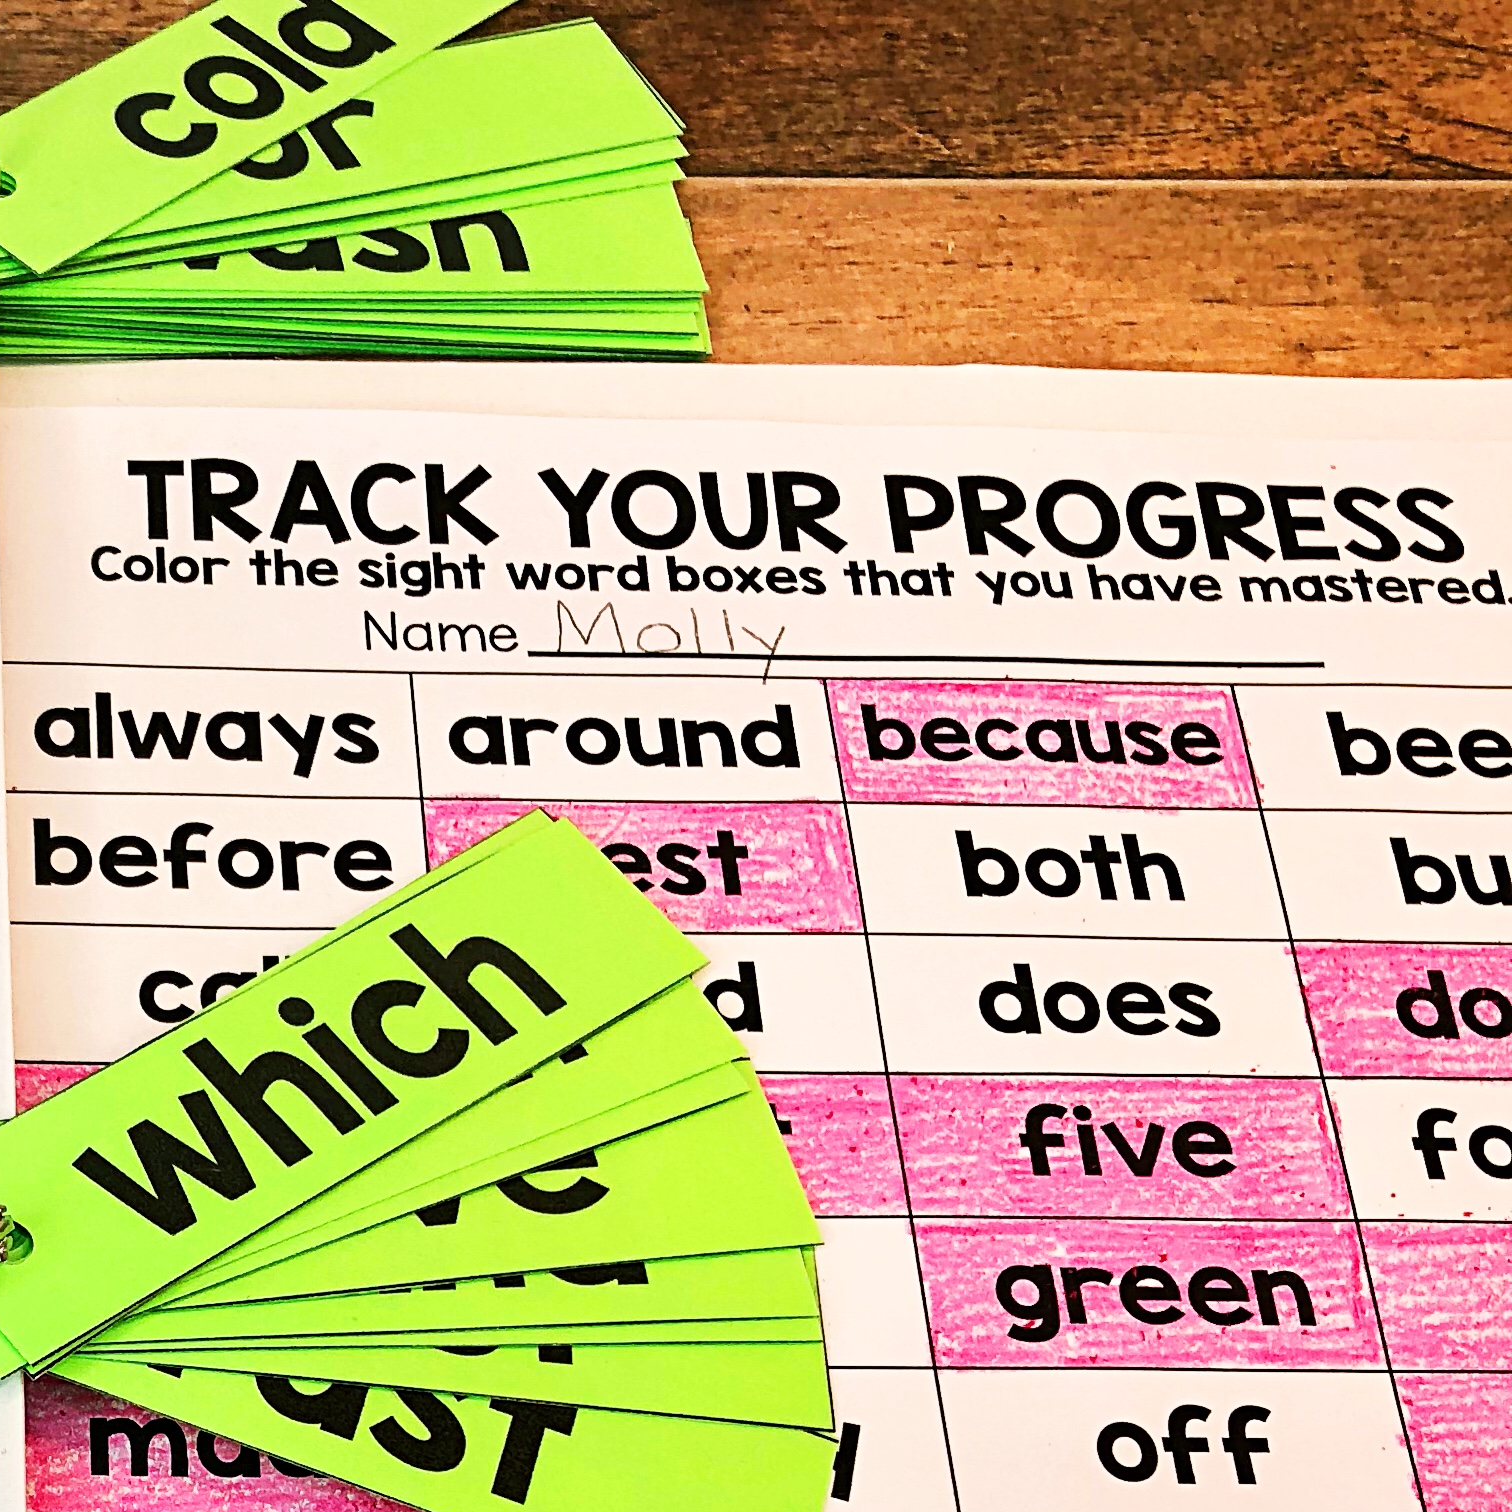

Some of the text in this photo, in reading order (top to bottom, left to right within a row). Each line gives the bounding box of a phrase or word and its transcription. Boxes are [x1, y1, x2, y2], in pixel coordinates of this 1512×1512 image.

[128, 458, 1464, 563] TRACK YOUR PROGRESS
[92, 546, 229, 584] Color
[249, 549, 339, 587] the
[359, 552, 485, 596] sight
[506, 556, 649, 591] word
[666, 556, 826, 595] boxes
[844, 560, 954, 596] that
[976, 571, 1073, 605] you
[1087, 565, 1222, 601] have
[364, 611, 518, 652] Name
[556, 599, 785, 685] Molly
[35, 692, 379, 778] always
[449, 705, 800, 767] around
[861, 704, 1222, 765] because
[33, 819, 393, 891] before
[955, 830, 1185, 900] both
[979, 964, 1220, 1037] does
[71, 923, 568, 1236] which
[1019, 1104, 1236, 1177] five
[996, 1265, 1316, 1342] green
[1097, 1405, 1271, 1484] off
